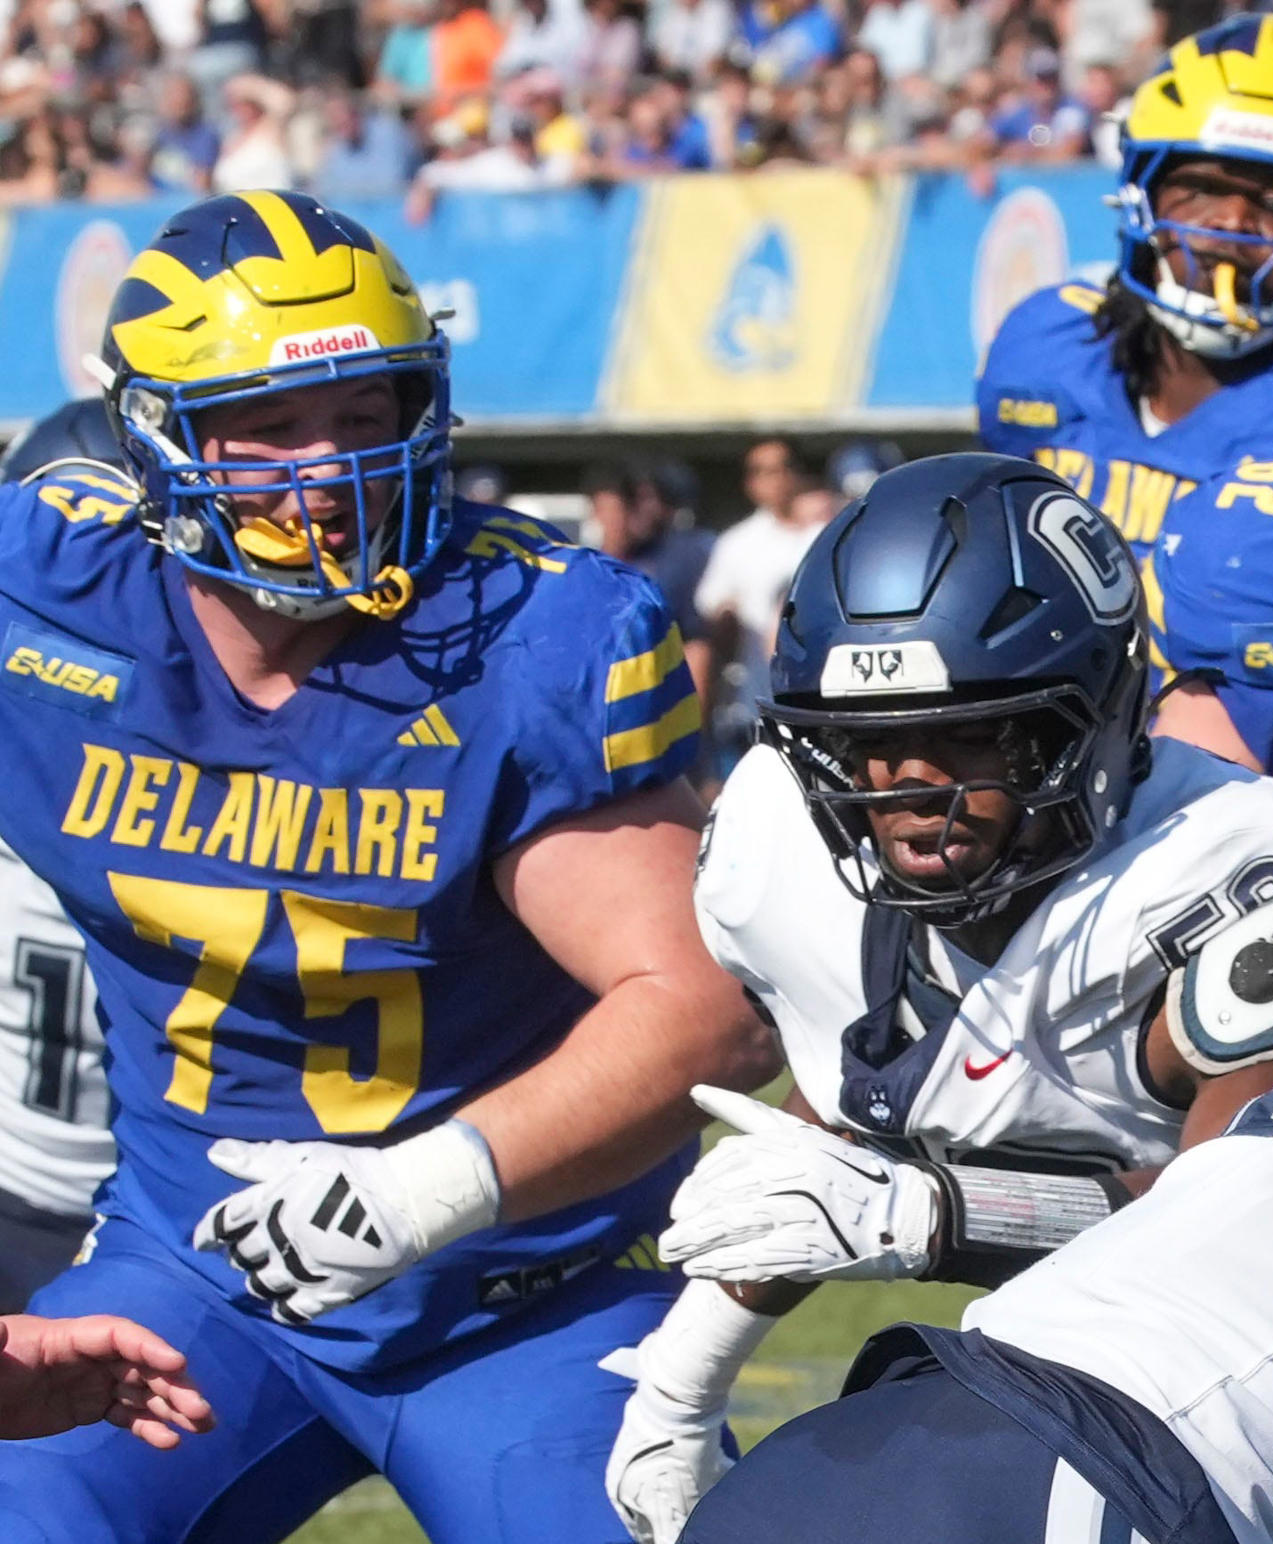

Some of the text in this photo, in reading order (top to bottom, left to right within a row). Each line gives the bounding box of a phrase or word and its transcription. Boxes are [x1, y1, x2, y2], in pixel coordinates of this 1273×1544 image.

[284, 331, 368, 360] Riddell
[61, 743, 445, 881] DELAWARE
[107, 871, 424, 1135] 75
